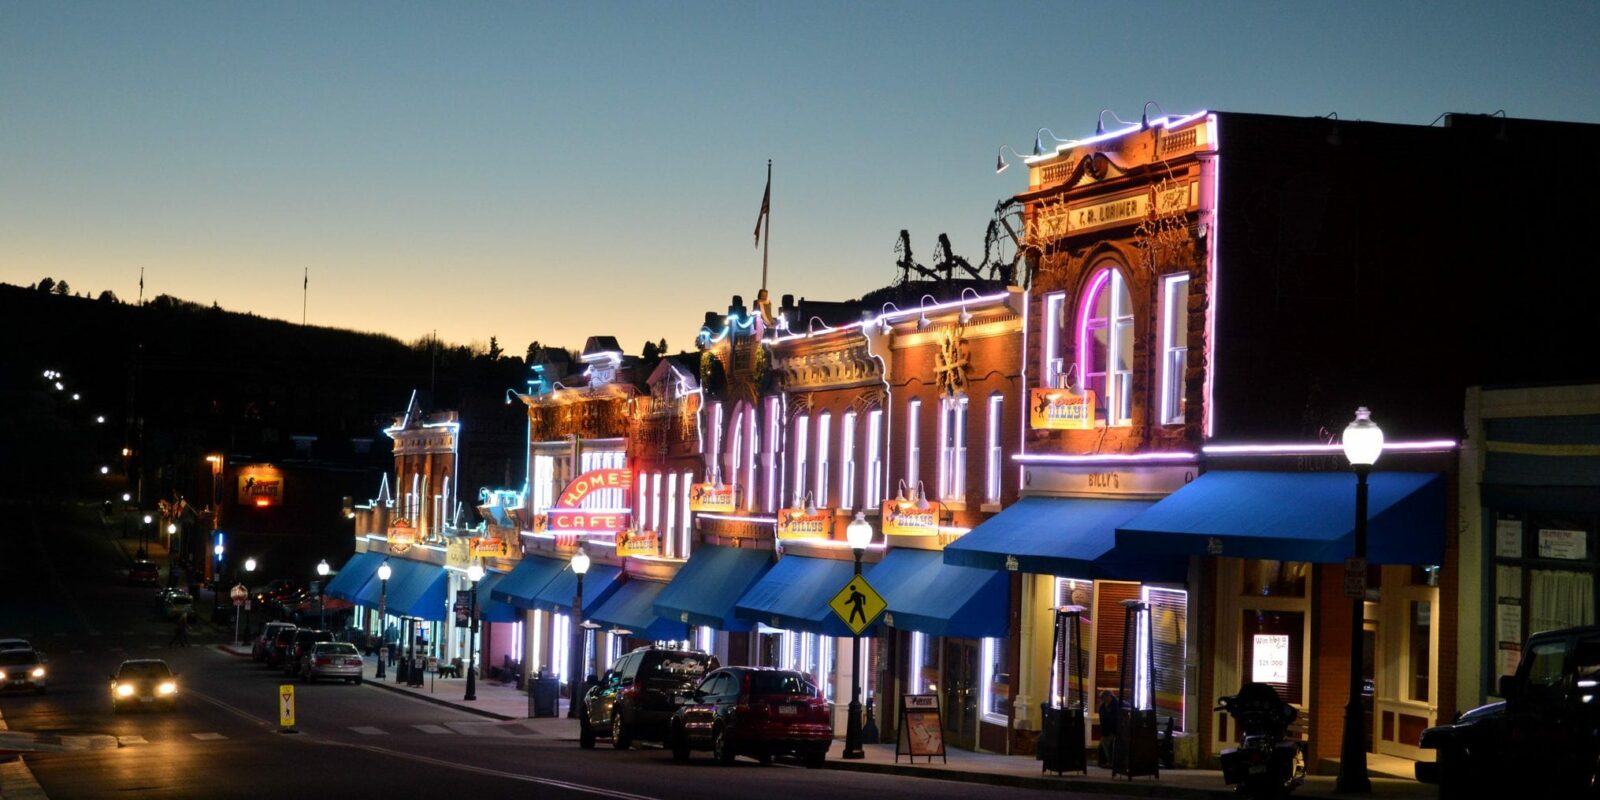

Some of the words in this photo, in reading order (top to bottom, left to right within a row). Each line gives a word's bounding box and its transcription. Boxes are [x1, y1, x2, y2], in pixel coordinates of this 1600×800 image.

[1099, 200, 1138, 221] LORIMER
[564, 472, 620, 506] HOME
[1088, 472, 1119, 488] BILLY'S
[557, 515, 617, 528] CAFE
